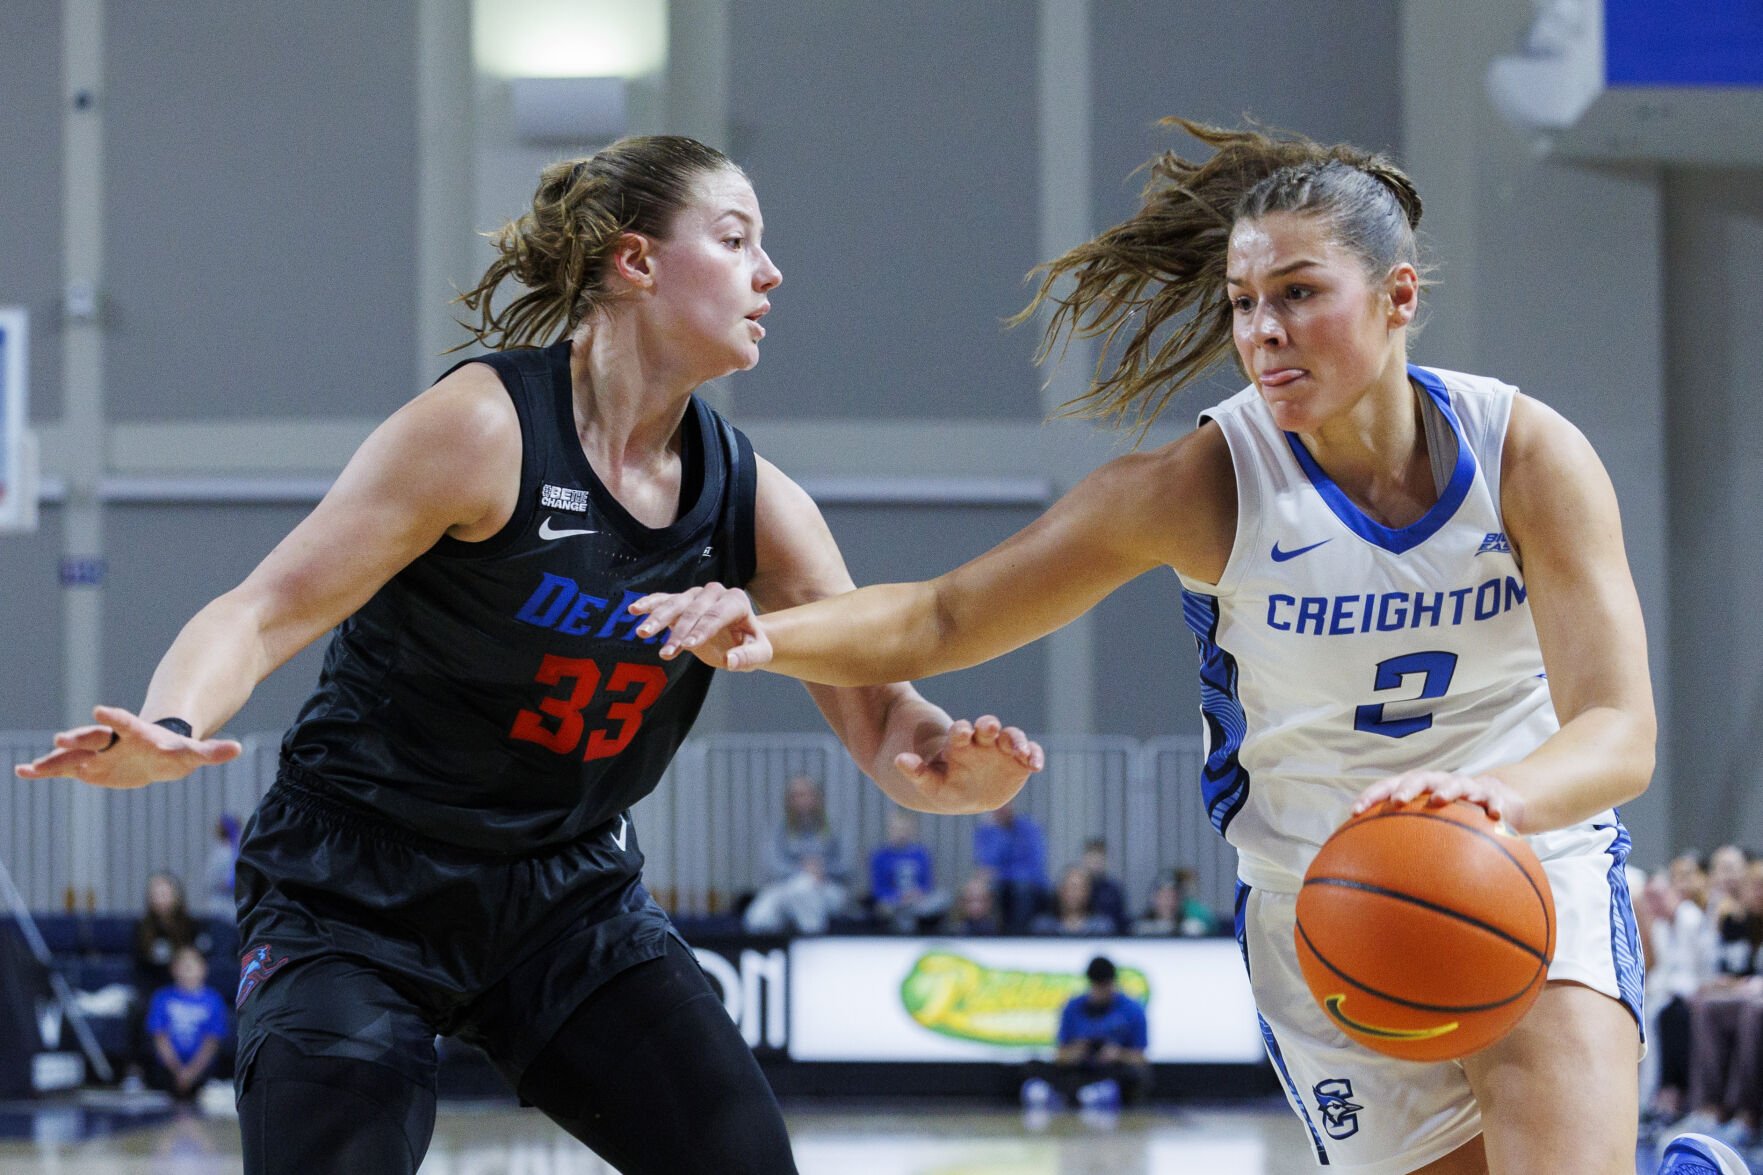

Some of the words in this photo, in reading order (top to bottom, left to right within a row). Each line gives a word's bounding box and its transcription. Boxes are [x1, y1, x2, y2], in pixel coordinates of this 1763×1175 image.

[541, 496, 588, 512] CHANGE
[1267, 575, 1528, 636] CREIGHTON
[509, 653, 669, 762] 33
[1354, 650, 1459, 739] 2
